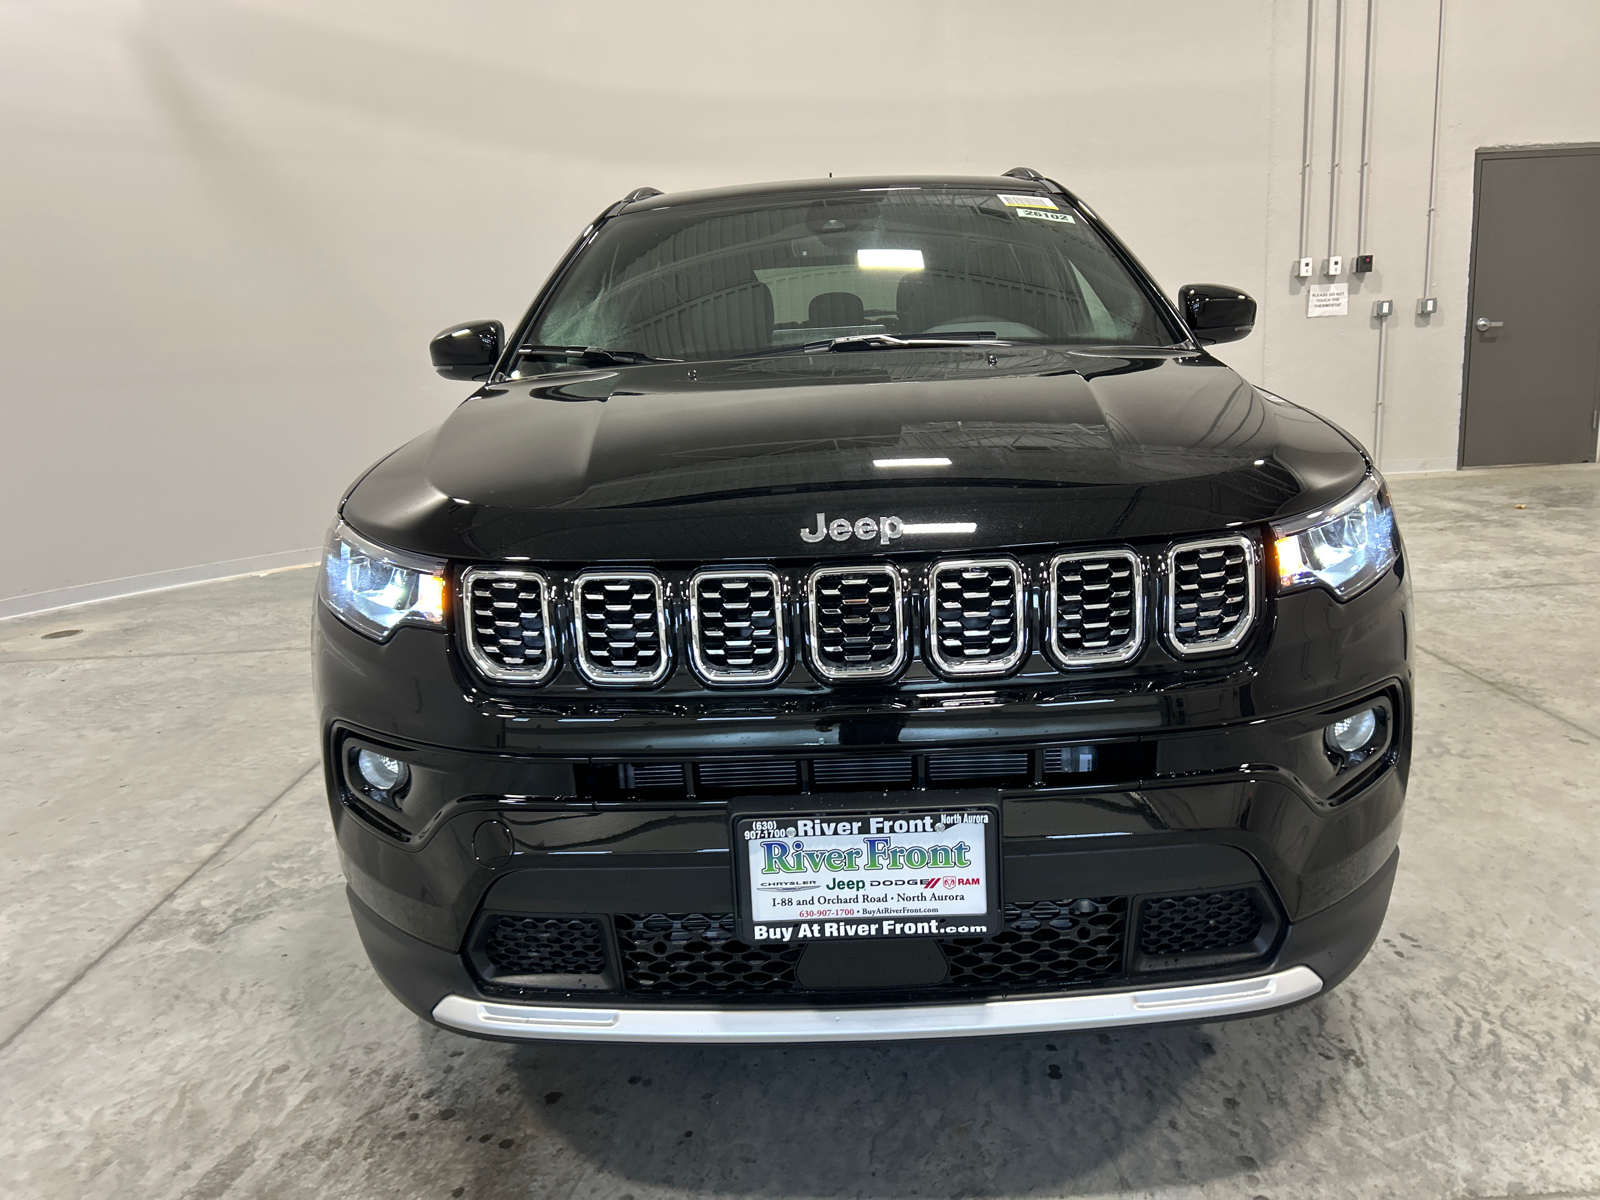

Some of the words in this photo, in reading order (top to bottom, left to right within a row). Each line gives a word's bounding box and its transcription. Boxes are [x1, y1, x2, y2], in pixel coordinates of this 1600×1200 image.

[1024, 210, 1069, 221] 26102
[800, 512, 904, 545] Jeep
[940, 814, 961, 825] North
[963, 813, 989, 824] Aurora
[752, 820, 777, 831] (630)
[797, 819, 862, 836] River
[869, 816, 934, 834] Front
[744, 828, 786, 840] 907-1700
[760, 840, 863, 875] River
[863, 836, 972, 871] Front
[826, 877, 866, 892] Jeep
[870, 878, 930, 887] DODGE
[957, 877, 980, 886] RAM
[772, 897, 793, 907] I-88
[796, 896, 815, 906] and
[817, 894, 859, 905] Orchard
[862, 893, 888, 903] Road
[896, 892, 927, 903] North
[929, 892, 965, 902] Aurora
[798, 908, 855, 918] 630-907-1700
[862, 906, 939, 916] BuyAtRiverFront.com
[754, 925, 793, 942] Buy
[797, 923, 821, 938] At
[824, 921, 879, 937] River
